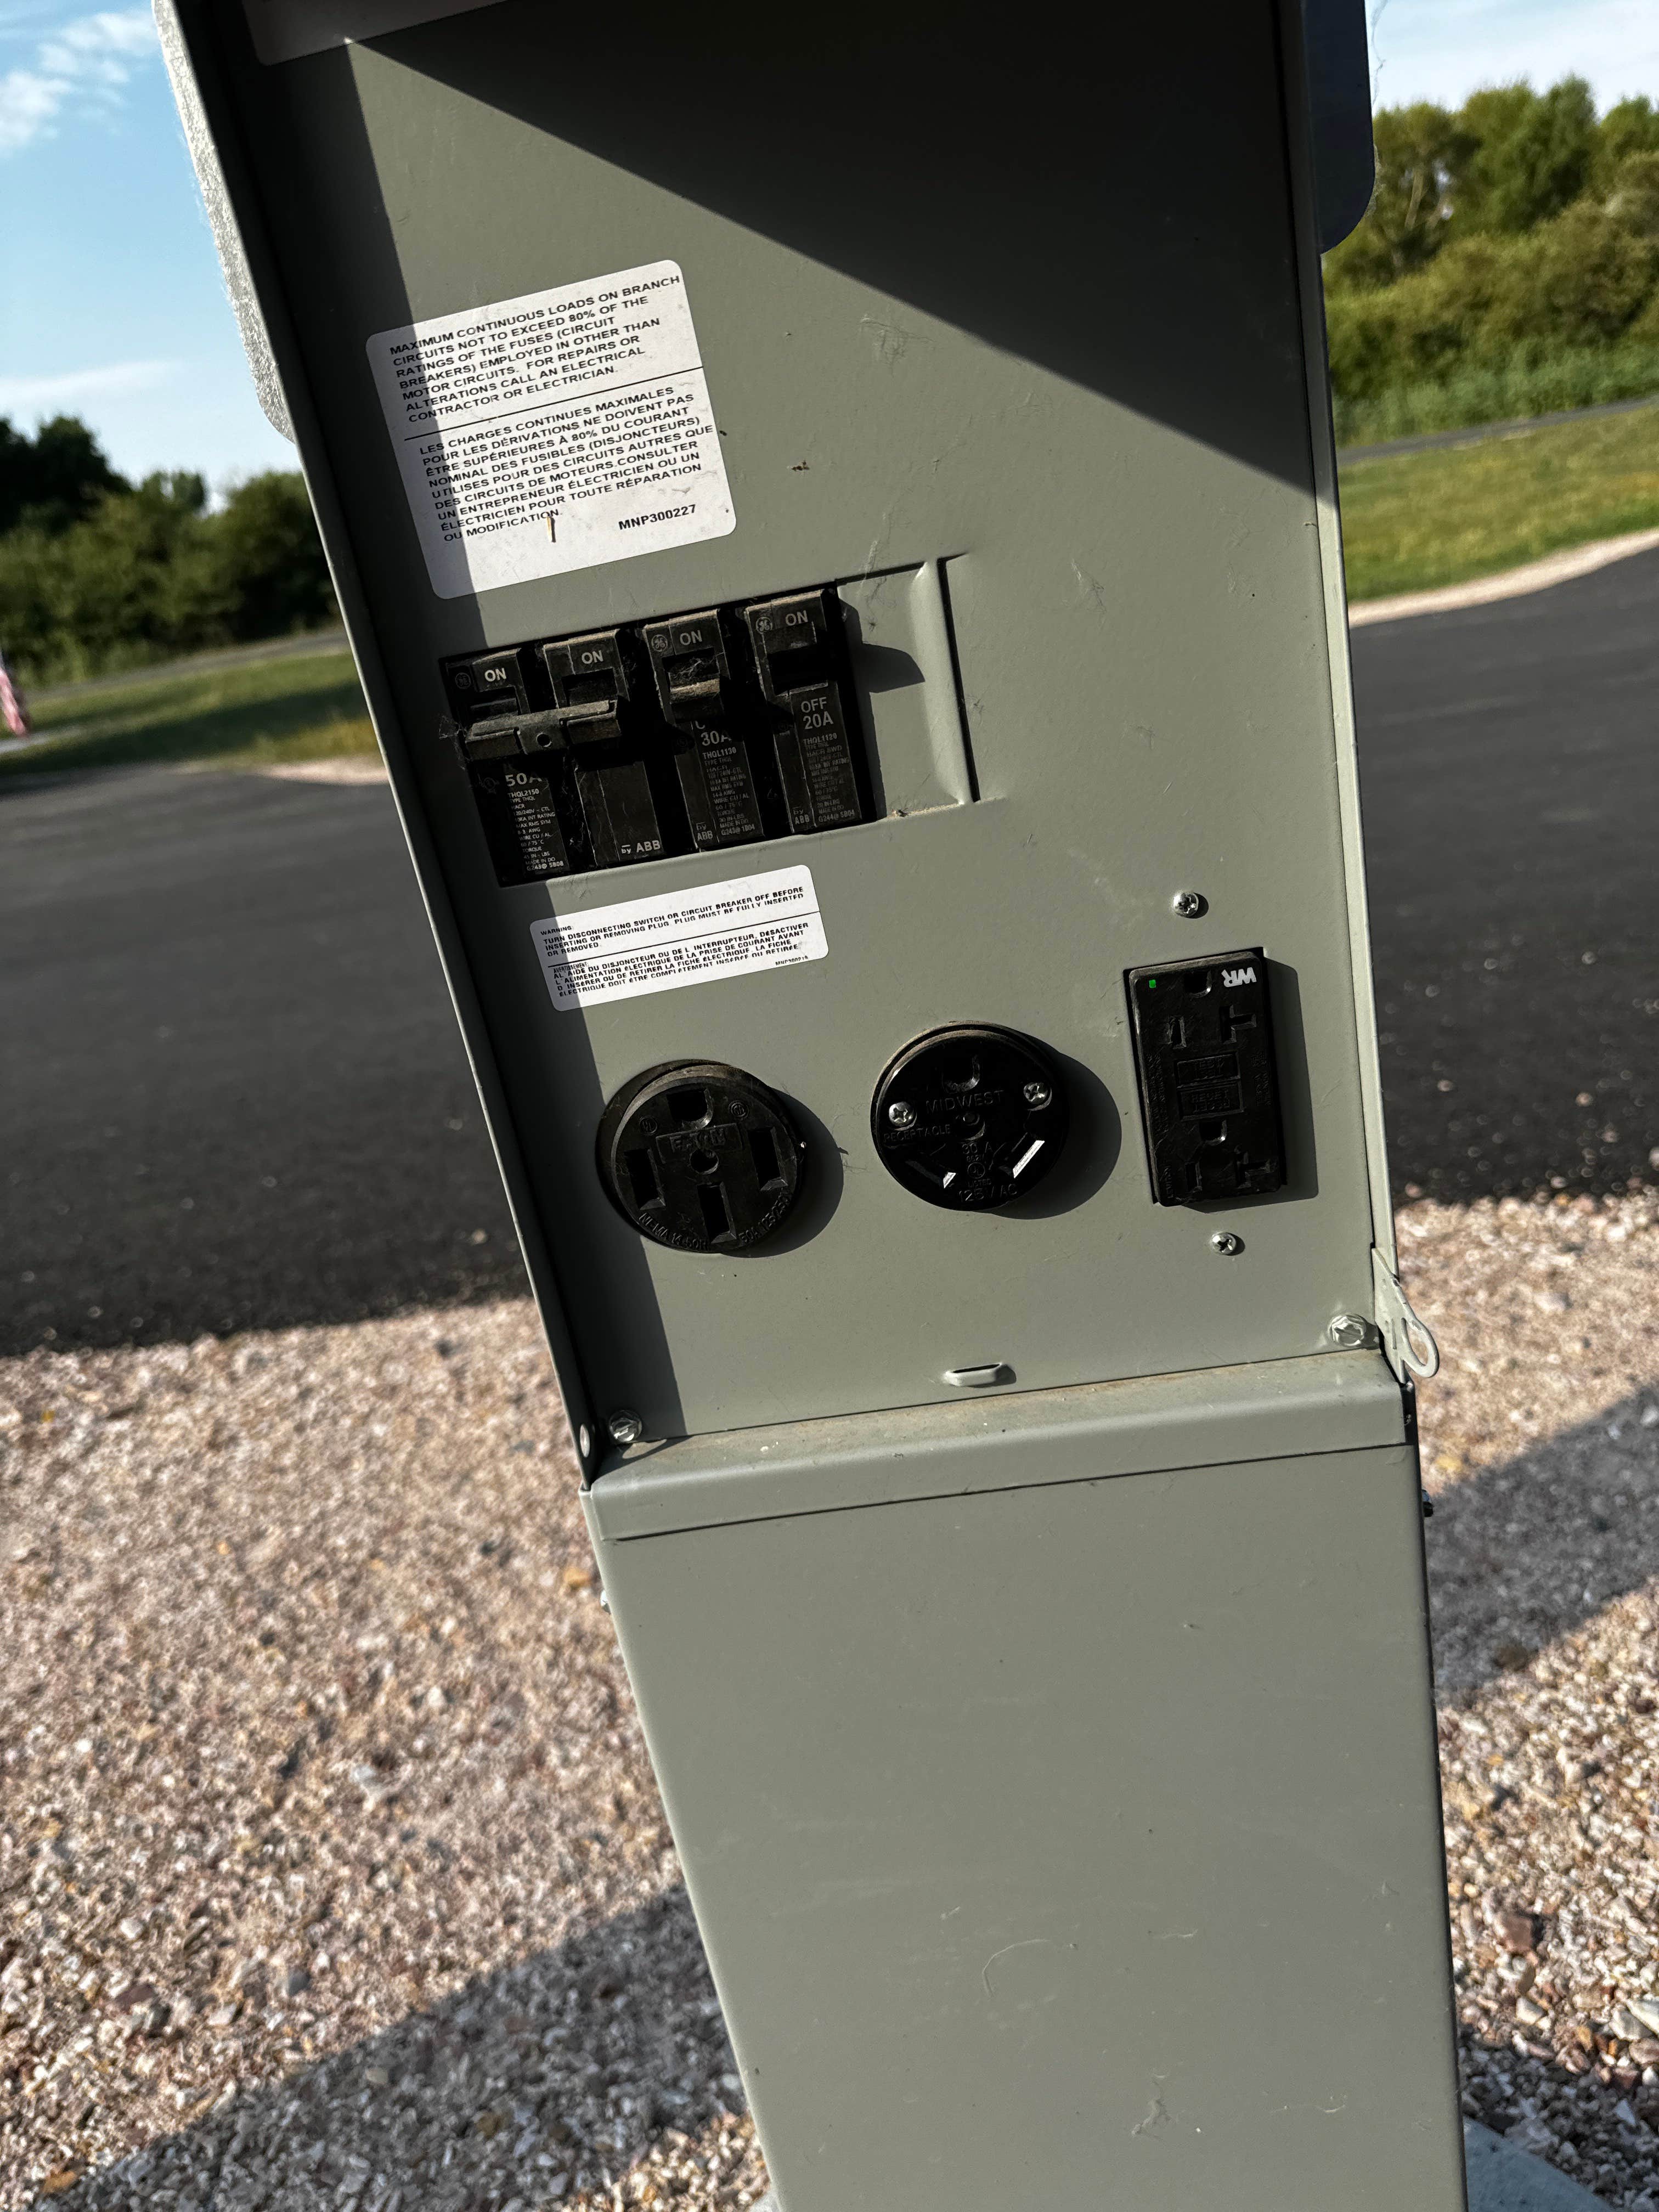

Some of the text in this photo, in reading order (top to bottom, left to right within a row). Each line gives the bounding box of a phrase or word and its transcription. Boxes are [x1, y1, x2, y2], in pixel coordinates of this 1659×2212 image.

[390, 275, 680, 354] MAXIMUM CONTINUOUS LOADS ON BRANCH
[392, 296, 648, 366] CIRCUITS NOT TO EXCEED 80% OF THE
[396, 316, 616, 377] RATINGS OF THE FUSES (CIRCUIT
[399, 318, 660, 390] BREAKERS) EMPLOYED IN OTHER THAN
[402, 335, 640, 400] MOTOR CIRCUITS. FOR REPAIRS OR
[404, 346, 645, 411] ALTERATIONS CALL AN ELECTRICAL
[408, 393, 500, 422] CONTRACTOR
[502, 388, 522, 399] OR
[419, 386, 674, 455] LES CHARGES CONTINUES MAXIMALES
[422, 393, 694, 466] POUR LES DÉRIVATIONS NE DOIVENT PAS
[425, 406, 690, 477] ÊTRE SUPÉRIEURES À 80% DU COURANT
[428, 416, 700, 488] NOMINAL DES FUSIBLES (DISJONCTEURS)
[492, 469, 530, 484] POUR
[532, 461, 560, 475] DES
[562, 445, 624, 467] CIRCUITS
[627, 432, 681, 452] AUTRES
[684, 425, 713, 438] QUE
[435, 496, 461, 510] DES
[464, 482, 524, 503] CIRCUITS
[528, 476, 546, 487] DE
[437, 452, 699, 521] UN ENTREPRENEUR ÉLECTRICIEN OU UN
[440, 461, 701, 532] ÉLECTRICIEN POUR TOUTE RÉPARATION
[618, 503, 697, 530] MNP300227
[443, 531, 463, 543] OU
[786, 610, 809, 626] ON
[680, 630, 703, 646] ON
[581, 650, 604, 664] ON
[484, 667, 507, 682] ON
[801, 696, 827, 713] OFF
[803, 711, 834, 730] 20A
[701, 730, 732, 746] 30A
[507, 788, 539, 799] THQL2150
[795, 814, 810, 825] ABB
[621, 840, 661, 855] by ABB
[697, 830, 713, 841] ABB
[543, 935, 565, 945] TURN
[567, 922, 631, 940] DISCONNECTING
[633, 915, 665, 927] SWITCH
[680, 905, 713, 917] CIRCUIT
[715, 896, 752, 910] BREAKER
[754, 893, 770, 901] OFF
[772, 885, 803, 898] BEFORE
[545, 938, 588, 951] INSERTING
[603, 926, 645, 939] REMOVING
[647, 920, 671, 930] PLUG
[674, 915, 696, 924] PLUG
[697, 910, 721, 919] MUST
[698, 946, 722, 956] PRISE
[737, 935, 775, 948] COURANT
[777, 929, 804, 940] AVANT
[601, 953, 656, 970] DISJONCTEUR
[657, 950, 669, 958] OU
[629, 964, 662, 977] RETIRER
[676, 957, 700, 967] FICHE
[767, 938, 791, 949] FICHE
[608, 979, 626, 988] DOIT
[1221, 967, 1257, 988] WR
[926, 1089, 1006, 1114] MIDWEST
[884, 1124, 952, 1142] RECEPTACLE
